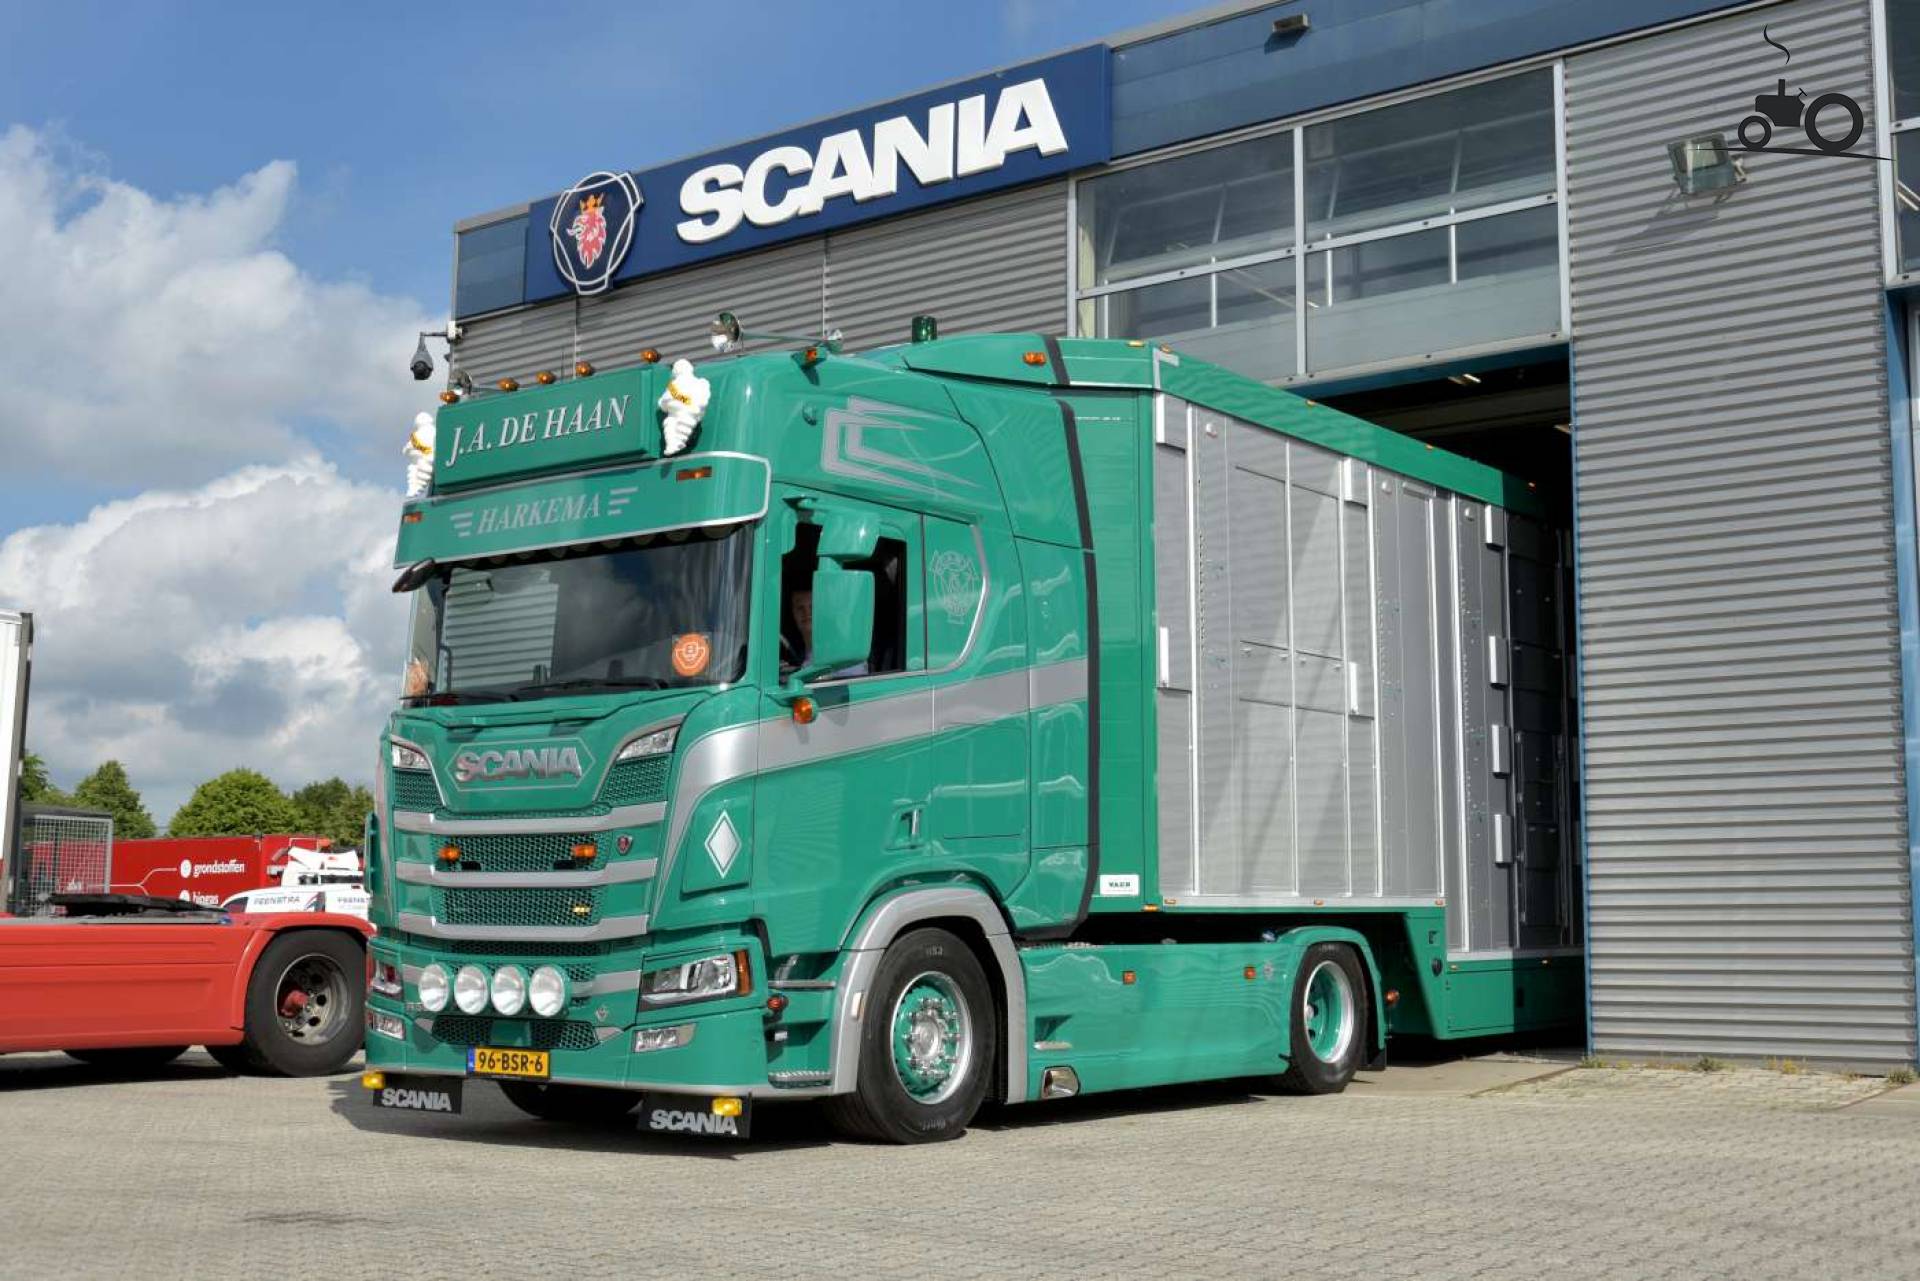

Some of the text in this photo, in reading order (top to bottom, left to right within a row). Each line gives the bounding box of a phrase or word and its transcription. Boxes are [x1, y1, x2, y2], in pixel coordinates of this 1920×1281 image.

[677, 77, 1068, 244] SCANIA
[445, 426, 491, 467] J.A.
[499, 413, 538, 447] DE
[542, 394, 631, 440] HAAN
[477, 492, 601, 535] HARKEMA
[455, 746, 583, 783] SCANIA
[193, 858, 245, 877] grondstoffen
[478, 1051, 544, 1073] 96-BSR-6
[381, 1087, 452, 1112] SCANIA
[649, 1108, 738, 1135] SCANIA
